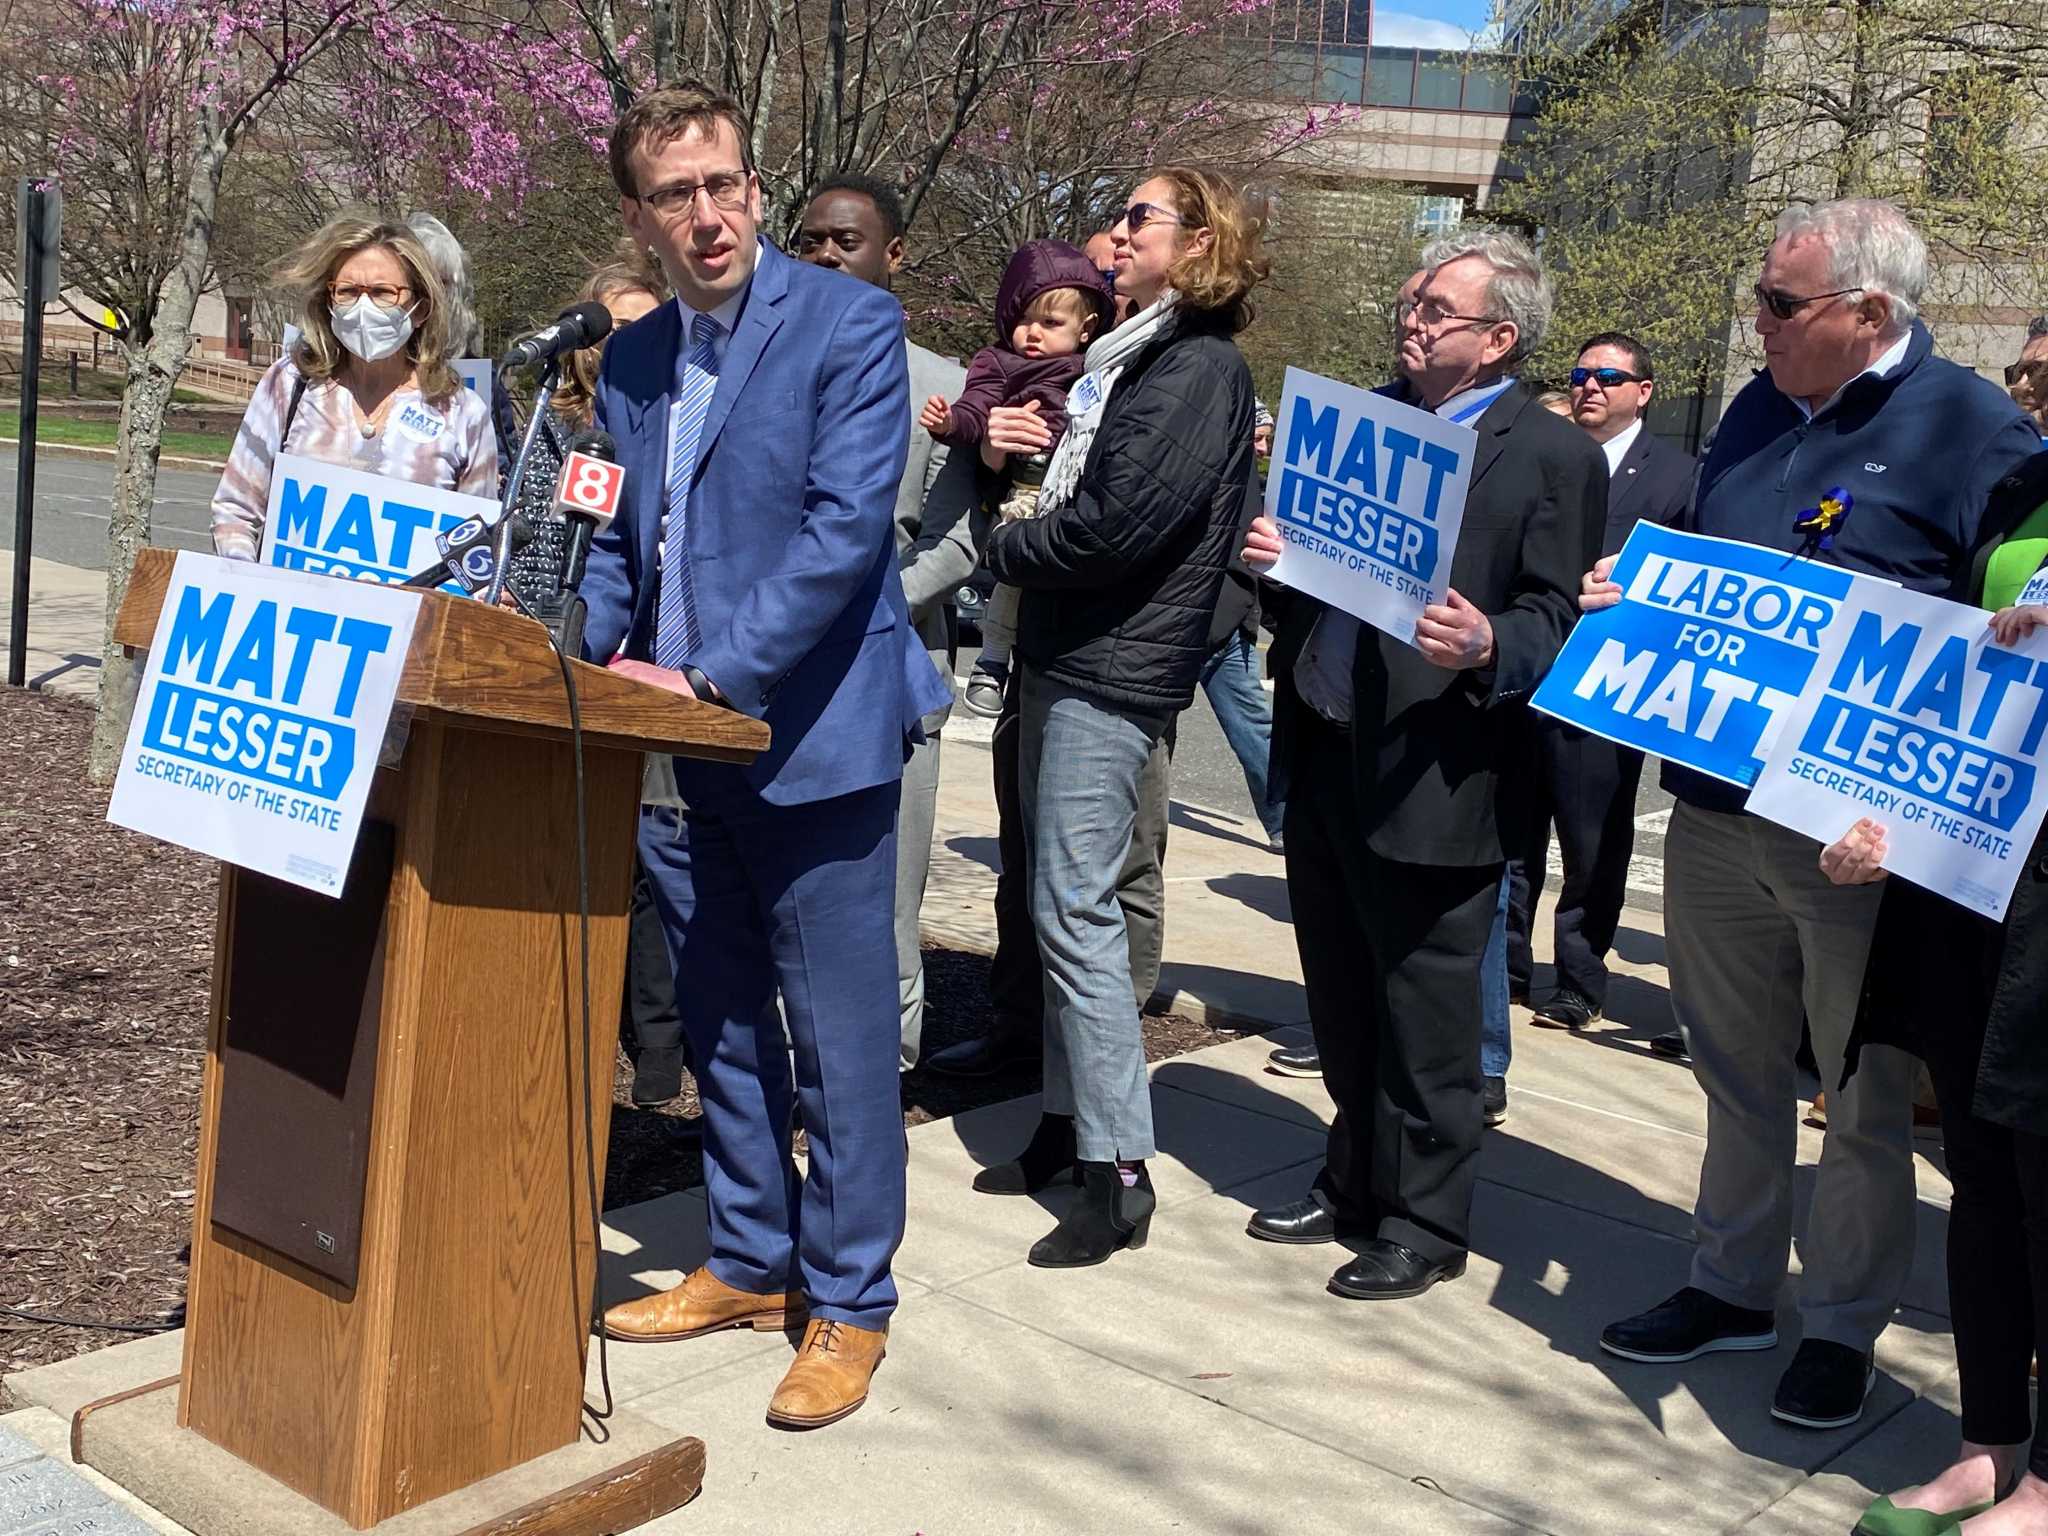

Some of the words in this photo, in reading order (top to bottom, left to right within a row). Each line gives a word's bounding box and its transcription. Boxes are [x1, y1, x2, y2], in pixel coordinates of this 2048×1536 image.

[402, 406, 443, 430] MATT
[1285, 395, 1459, 522] MATT
[276, 478, 466, 570] MAT
[572, 461, 609, 507] 8
[1291, 479, 1423, 572] LESSER
[1276, 522, 1346, 565] SECRETARY
[1348, 555, 1367, 573] OF
[1369, 562, 1394, 588] THE
[1396, 576, 1435, 605] STATE
[1646, 561, 1834, 648] LABOR
[161, 585, 392, 719] MATT
[1674, 623, 1746, 667] FOR
[159, 691, 333, 789] LESSER
[1573, 637, 1801, 762] MATT
[135, 754, 226, 797] SECRETARY
[227, 780, 252, 804] OF
[255, 787, 287, 816] THE
[288, 798, 342, 832] STATE
[1788, 757, 1902, 813] SECRETARY
[1903, 801, 1929, 824] OF
[1931, 811, 1965, 840] THE
[1962, 826, 2013, 861] STATE
[1822, 707, 2015, 820] LESSER
